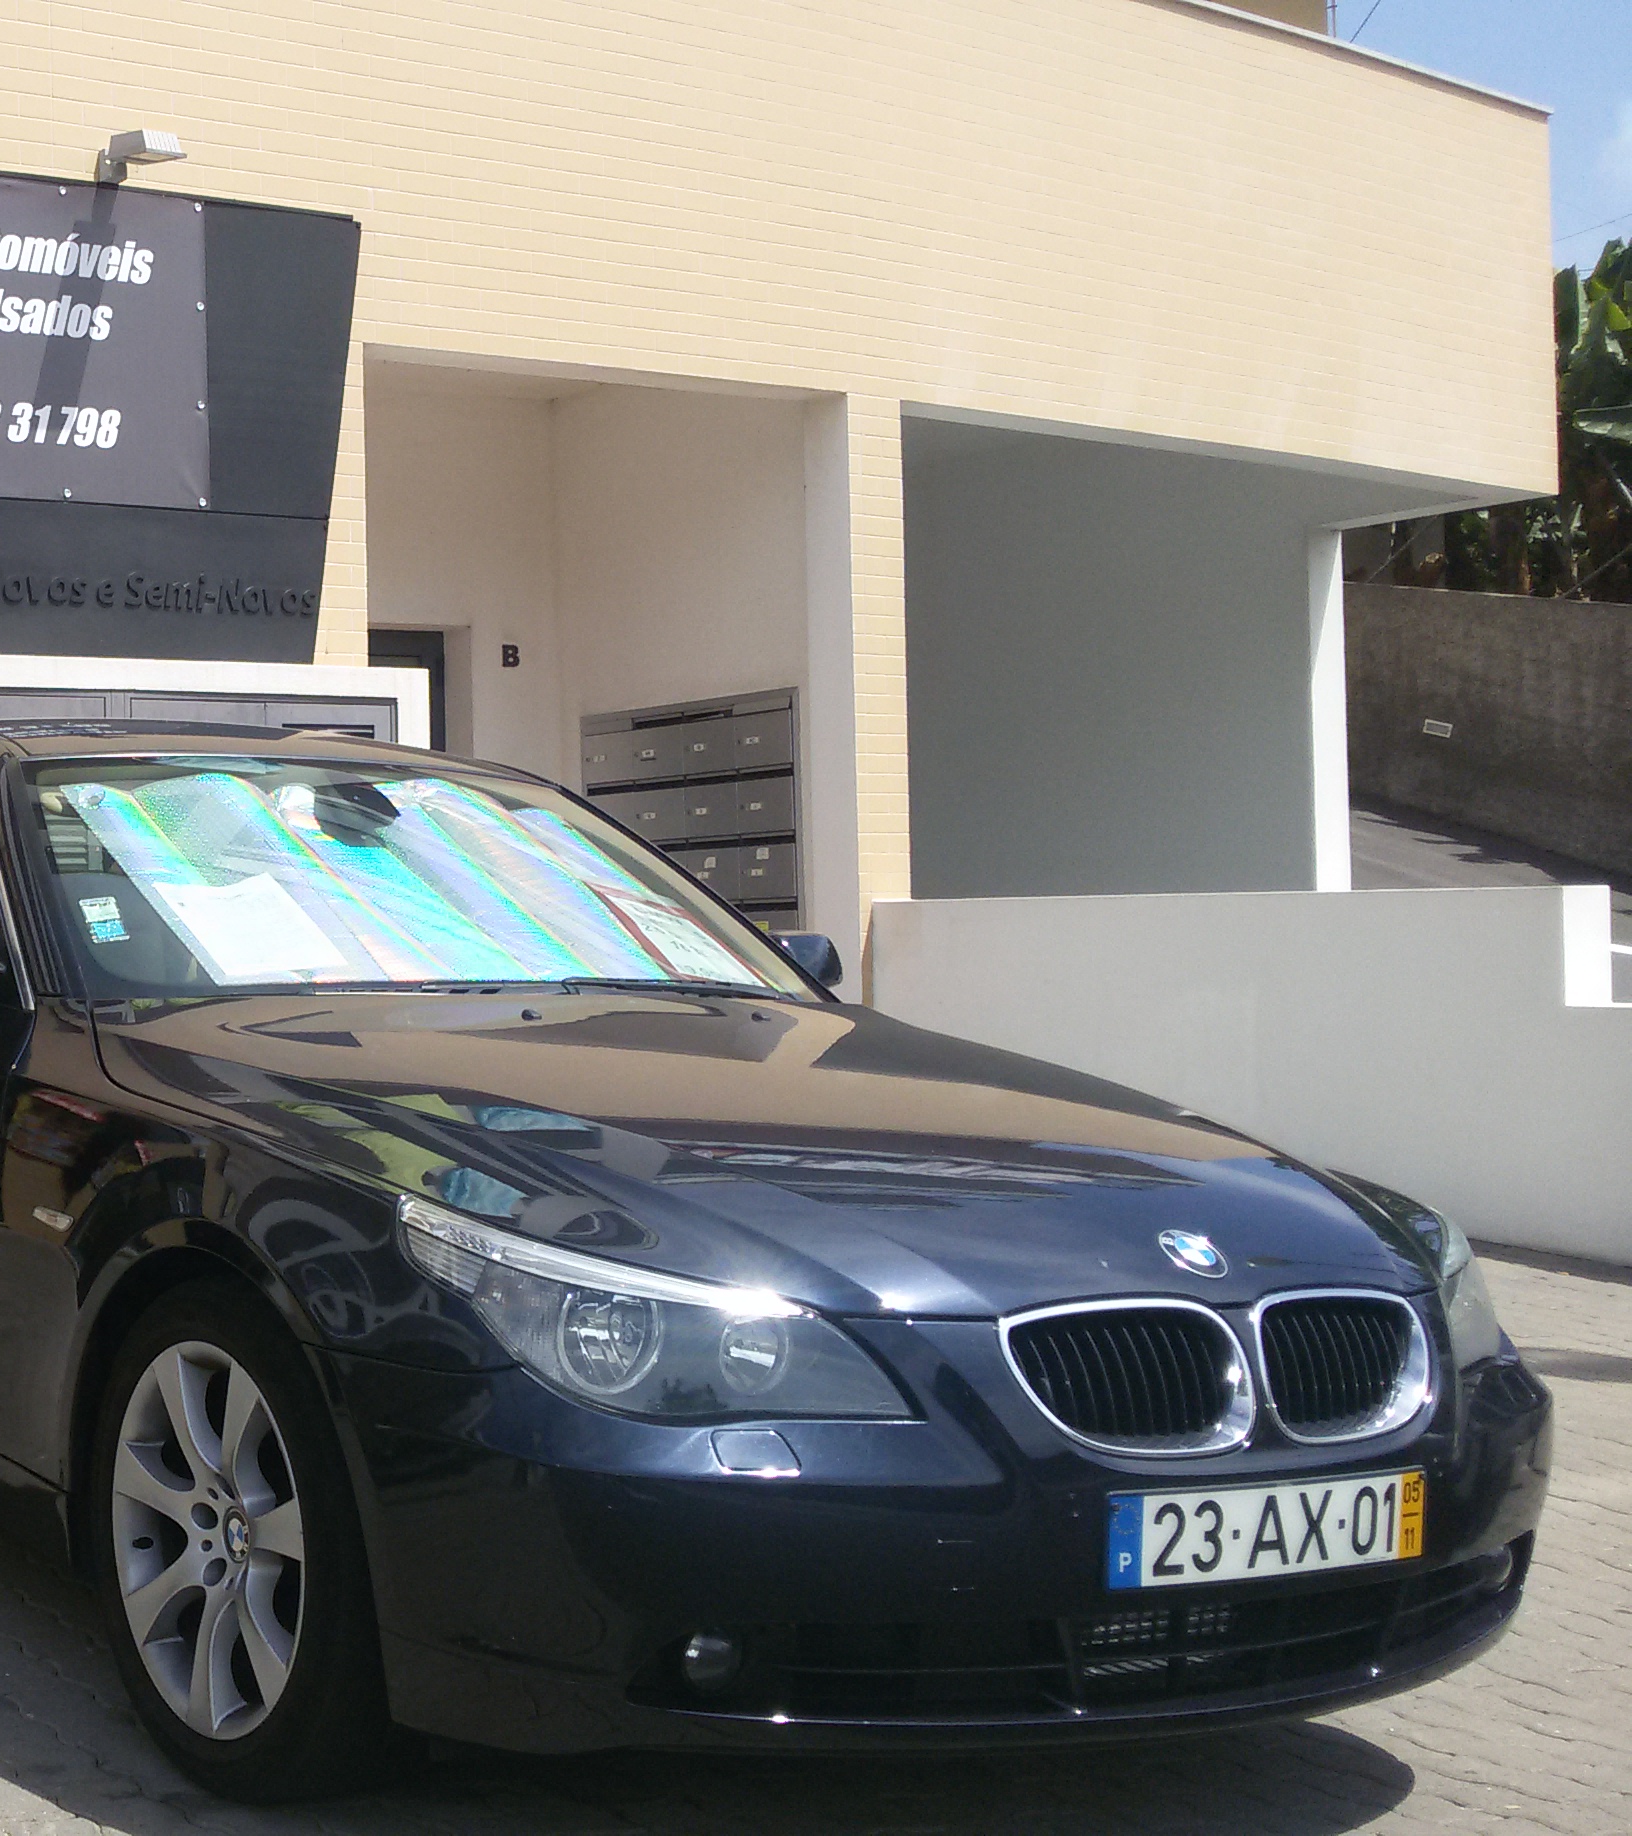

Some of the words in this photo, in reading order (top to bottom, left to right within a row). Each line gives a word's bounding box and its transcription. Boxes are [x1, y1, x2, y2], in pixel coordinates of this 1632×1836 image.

[8, 402, 52, 444] 31
[57, 406, 122, 449] 798
[96, 577, 115, 609] e
[123, 569, 317, 618] Semi-Novos
[501, 644, 520, 668] B
[1402, 1482, 1421, 1504] 05
[1404, 1527, 1416, 1550] 11
[1118, 1552, 1133, 1574] P
